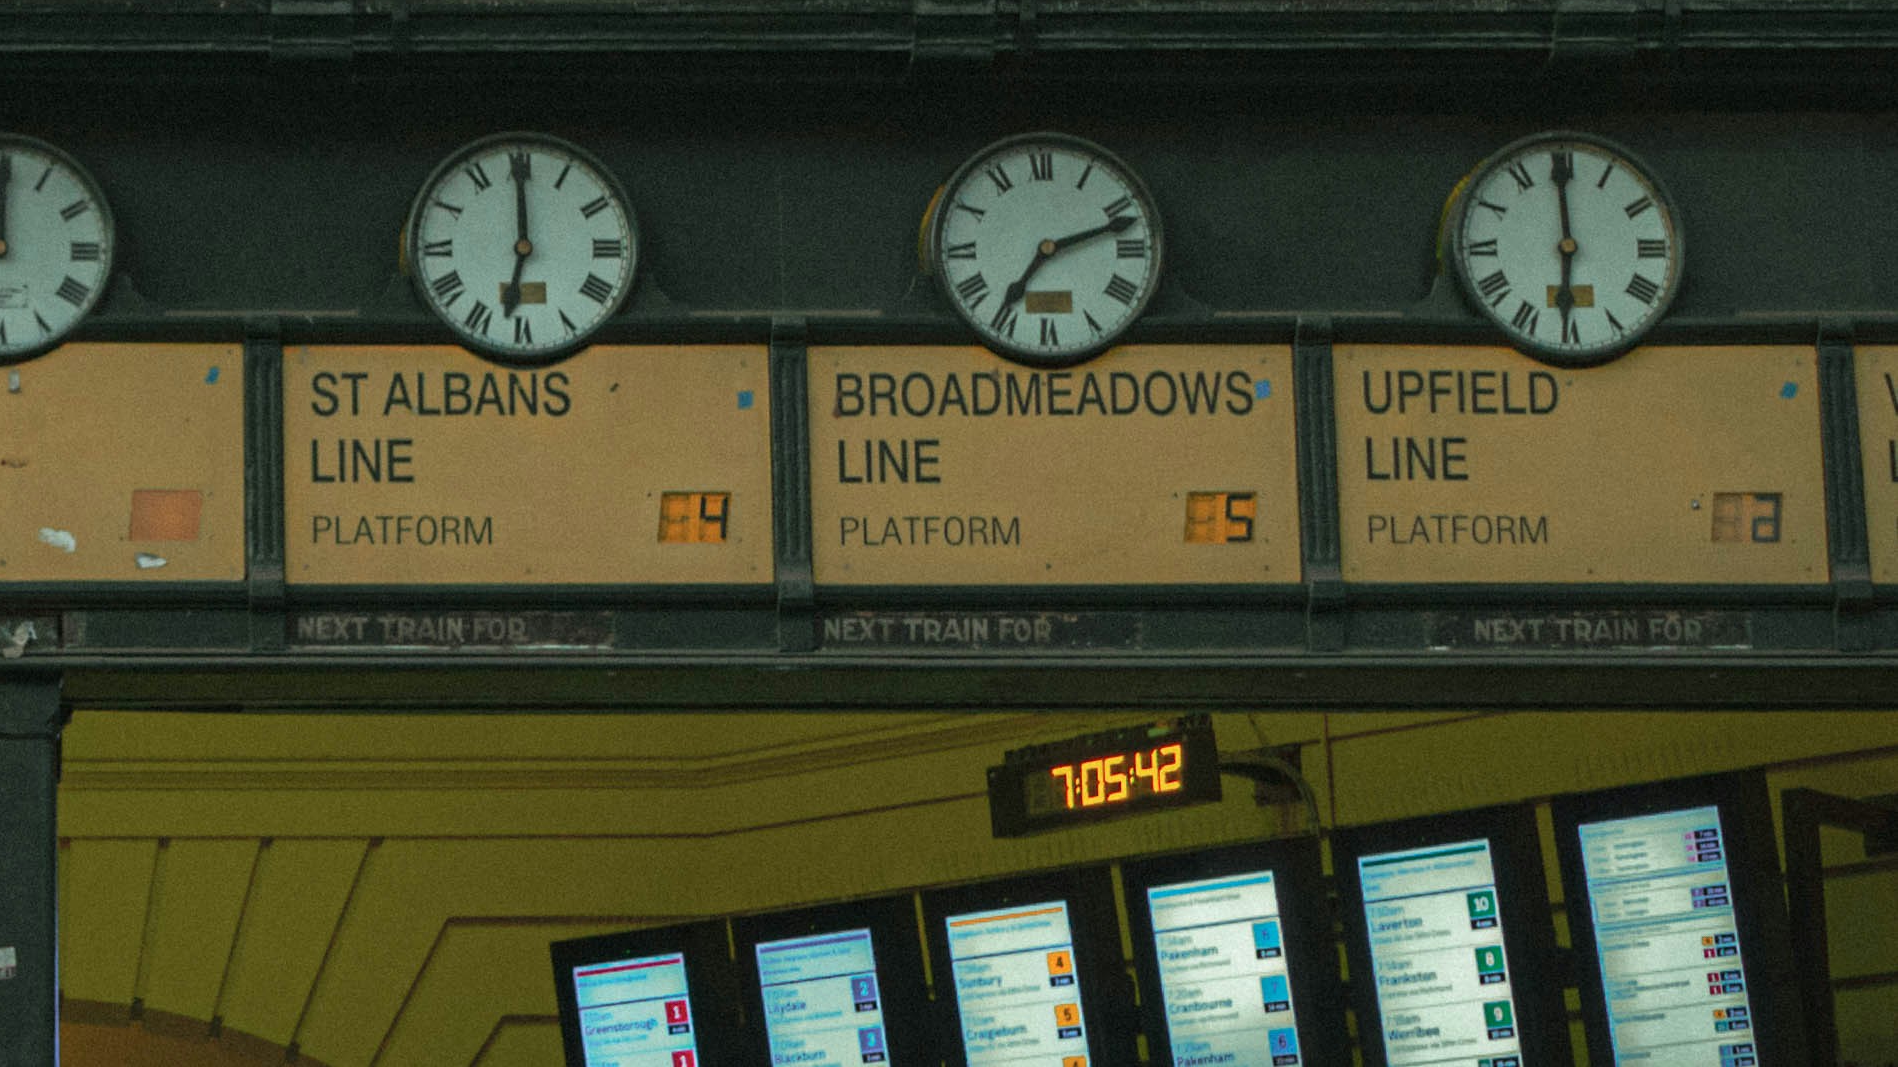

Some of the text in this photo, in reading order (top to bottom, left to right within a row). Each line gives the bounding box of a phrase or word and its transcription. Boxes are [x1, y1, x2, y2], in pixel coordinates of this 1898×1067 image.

[311, 371, 572, 417] ST ALBANS
[836, 370, 1253, 417] BROADMEADOWS
[1362, 370, 1560, 415] UPFIELD
[312, 439, 414, 483] LINE
[838, 439, 941, 483] LINE
[1366, 437, 1469, 481] LINE
[312, 515, 493, 546] PLATFORM
[701, 495, 728, 539] 4
[840, 516, 1020, 546] PLATFORM
[1226, 493, 1253, 542] 5
[1368, 514, 1548, 545] PLATFORM
[297, 617, 526, 641] NEXT TRAIN FOR
[824, 618, 1051, 641] NEXT TRAIN FOR
[1474, 619, 1702, 641] NEXT TRAIN FOR
[1052, 744, 1182, 809] 7:05:42
[1473, 896, 1489, 912] 10
[1161, 945, 1219, 960] Pakenham
[959, 976, 1002, 989] Sunbury
[1379, 971, 1438, 985] Frankston
[1170, 998, 1233, 1014] Cranbourne
[584, 1017, 659, 1036] Greensborough
[774, 1049, 827, 1064] Blackburn
[1177, 1051, 1235, 1067] Pakenham
